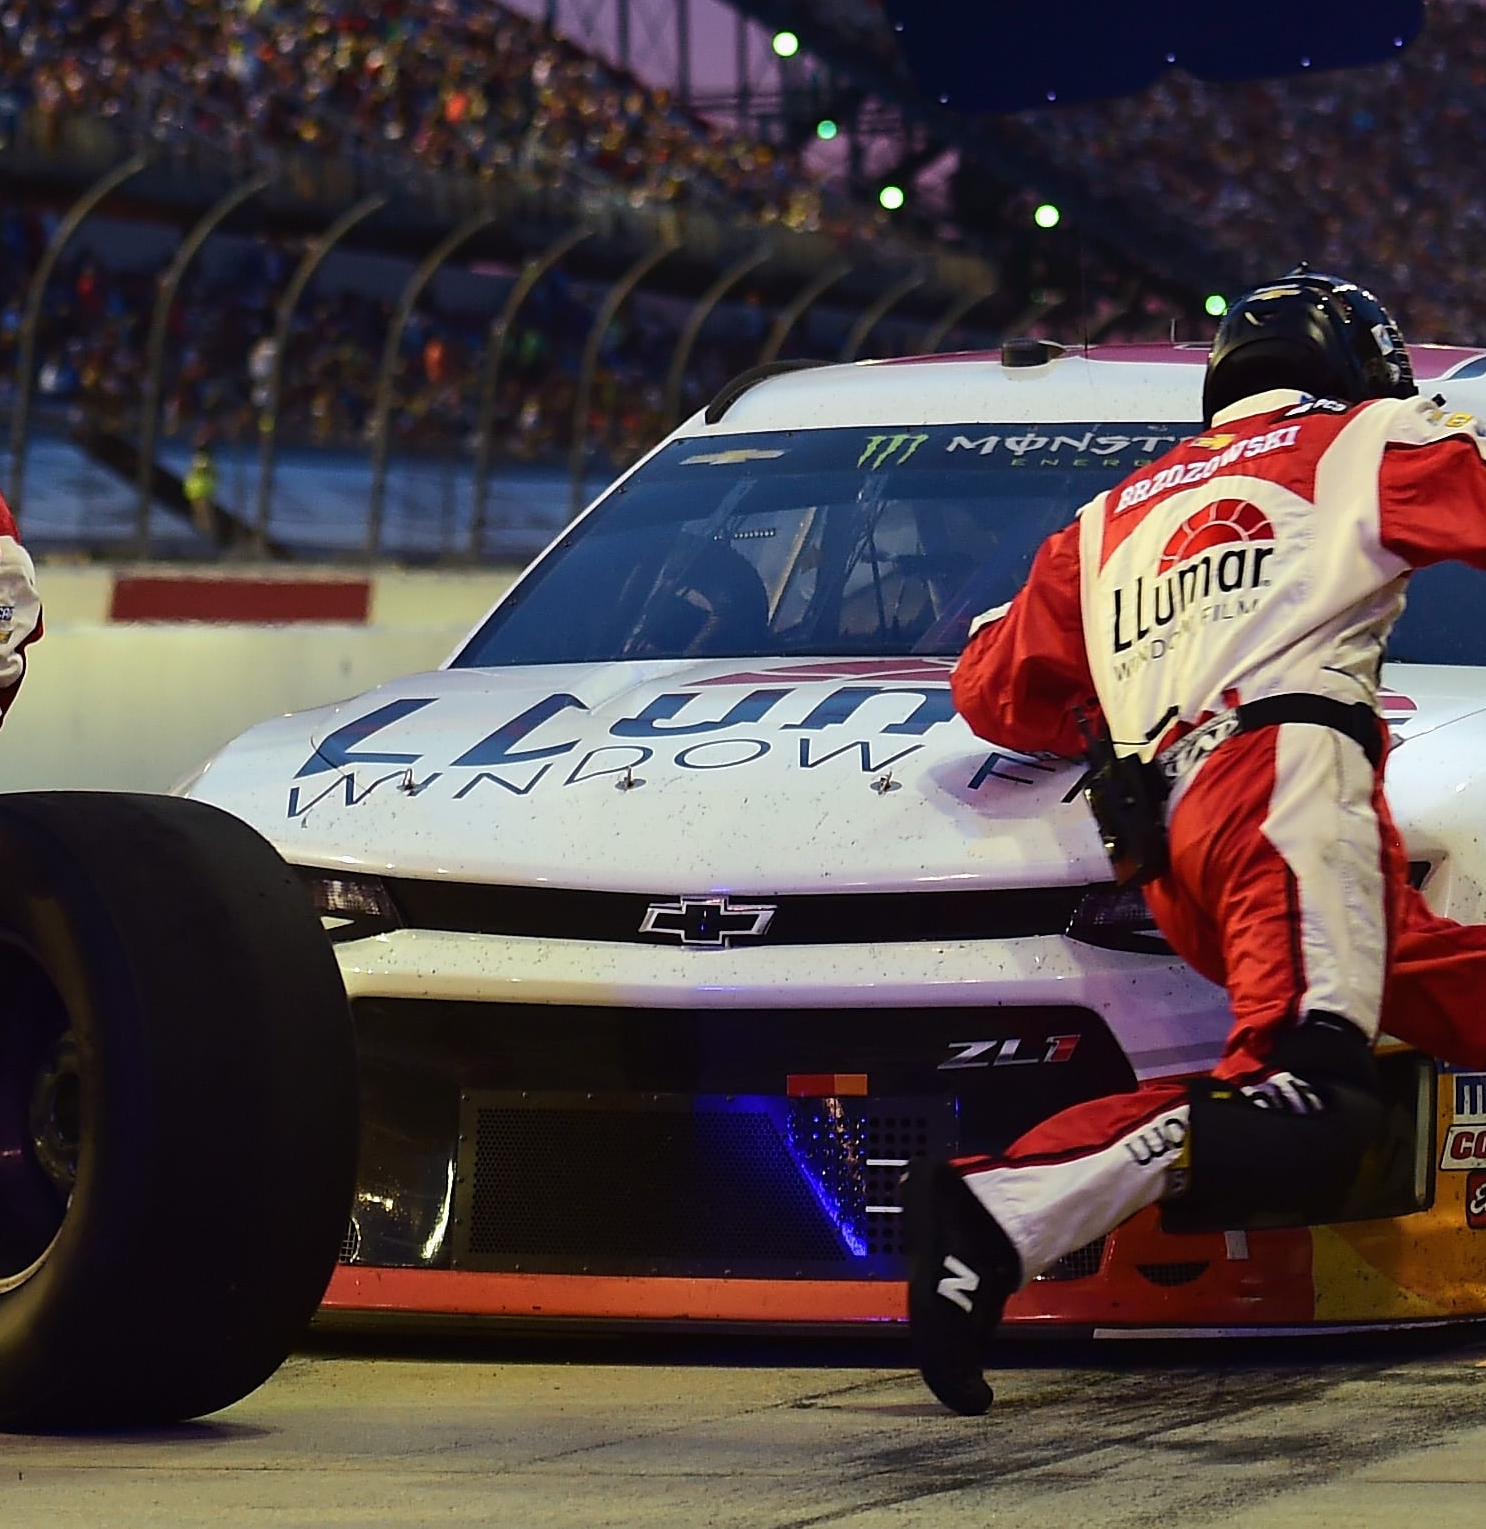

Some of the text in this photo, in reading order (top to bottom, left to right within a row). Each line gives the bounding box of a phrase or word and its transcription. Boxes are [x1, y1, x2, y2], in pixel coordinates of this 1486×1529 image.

[946, 432, 1196, 457] MONST
[1010, 457, 1154, 467] ENERG
[1114, 425, 1302, 515] BRZOZOWSKI
[1114, 546, 1274, 654] LLumar
[936, 1033, 1082, 1071] ZL1
